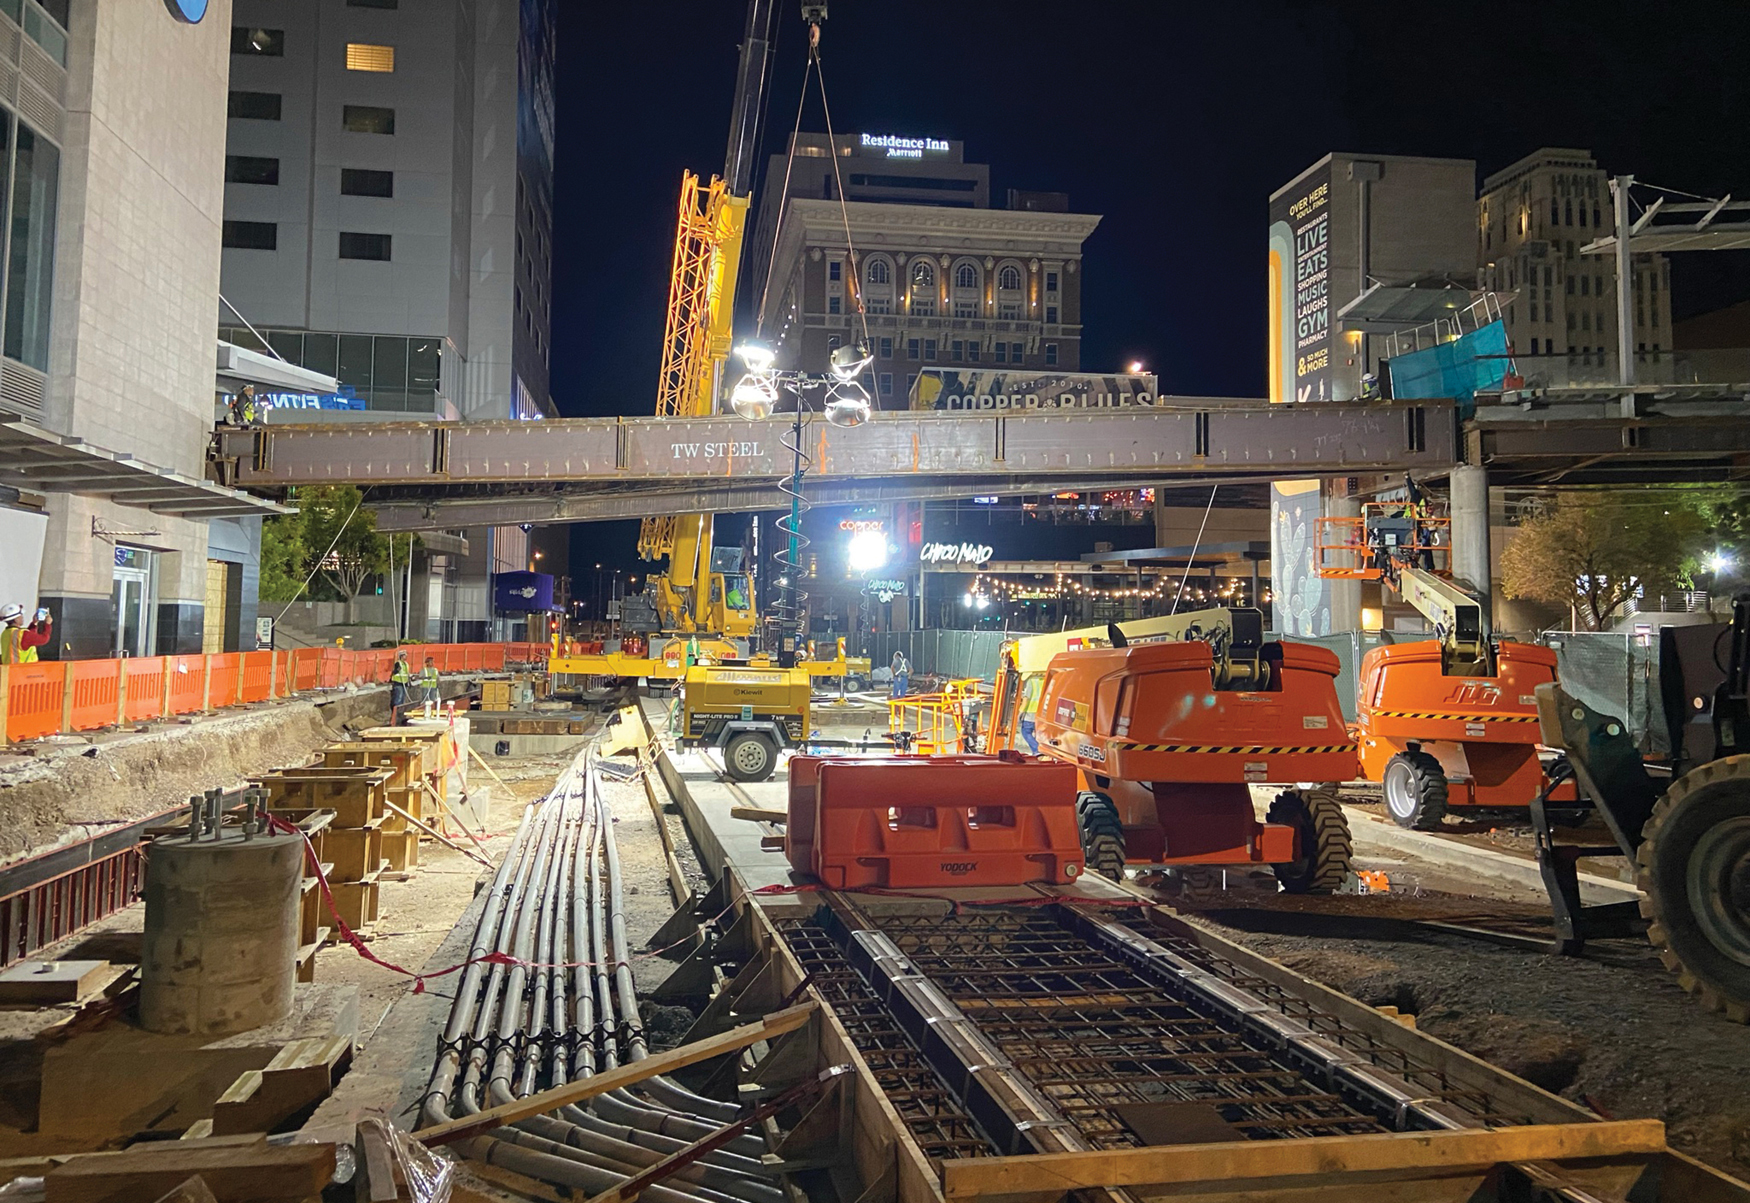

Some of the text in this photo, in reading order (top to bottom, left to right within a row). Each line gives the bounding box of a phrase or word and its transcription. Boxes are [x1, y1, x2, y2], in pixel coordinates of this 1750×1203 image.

[862, 133, 950, 151] Residence Inn
[1289, 183, 1328, 217] OVER HERE
[1297, 212, 1328, 236] RESTAURANTS
[1297, 221, 1328, 257] LIVE
[1297, 242, 1328, 264] ENTERTAINMENT
[1297, 250, 1328, 282] EATS
[1297, 269, 1328, 292] SHOPPING
[1298, 280, 1328, 306] MUSIC
[1297, 295, 1328, 319] LAUGHS
[1298, 308, 1328, 338] GYM
[1298, 329, 1328, 349] PHARMACY
[1306, 347, 1329, 362] SO MUCH
[1297, 355, 1329, 377] & MORE
[946, 393, 1040, 410] COPPER
[671, 442, 764, 459] TW STEEL
[1079, 744, 1106, 762] 660SJ
[940, 861, 979, 872] YODOCK
